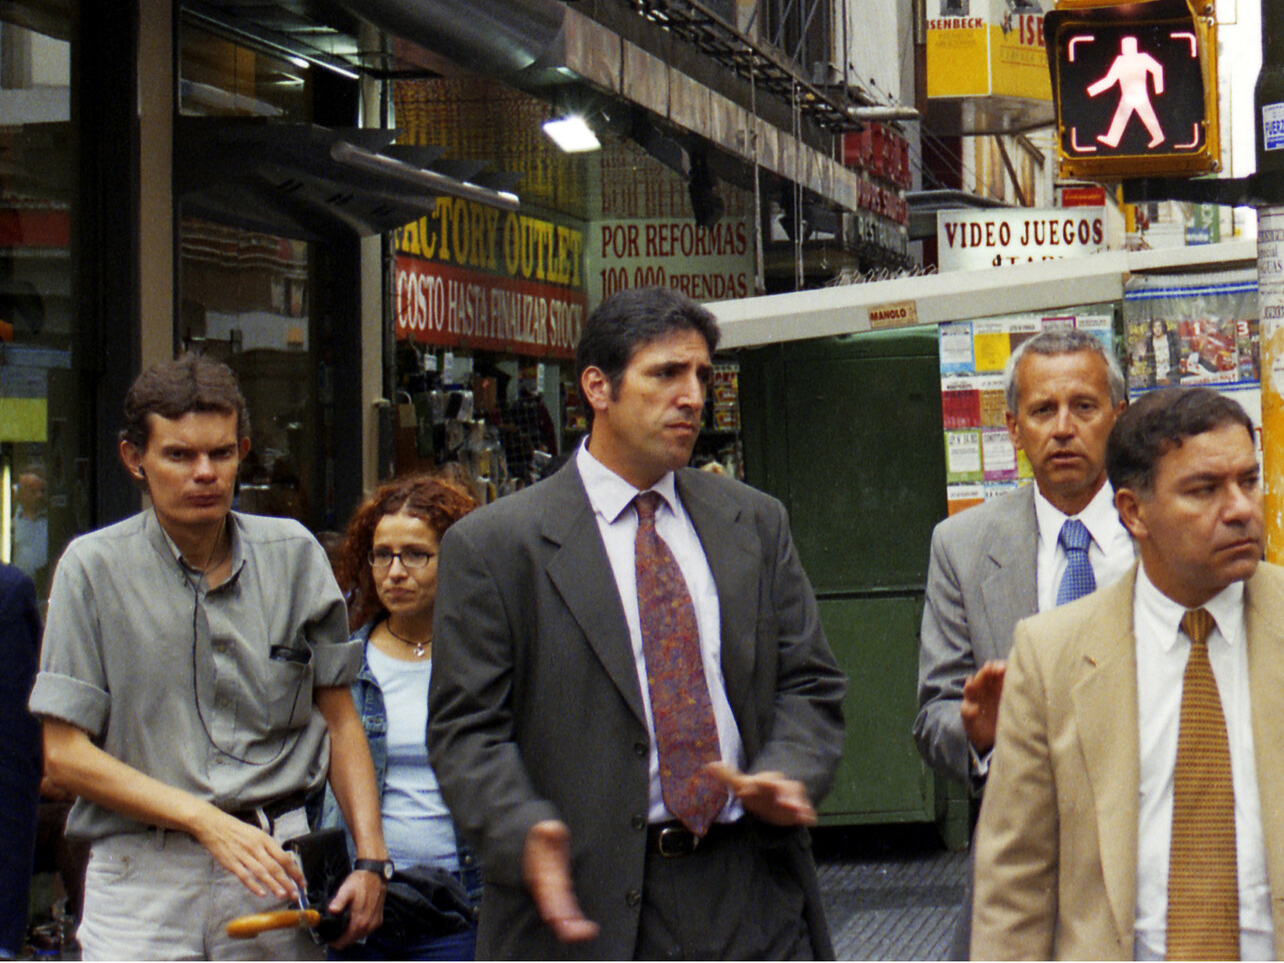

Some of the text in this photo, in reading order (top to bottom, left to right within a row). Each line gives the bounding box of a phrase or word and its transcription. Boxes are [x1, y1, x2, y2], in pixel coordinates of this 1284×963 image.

[504, 211, 582, 287] OUTLET
[602, 222, 747, 258] POR REFORMAS
[945, 219, 1104, 248] VIDEO JUEGOS
[398, 270, 445, 331] COSTO
[448, 279, 488, 337] HASTA
[670, 273, 747, 299] PRENDAS
